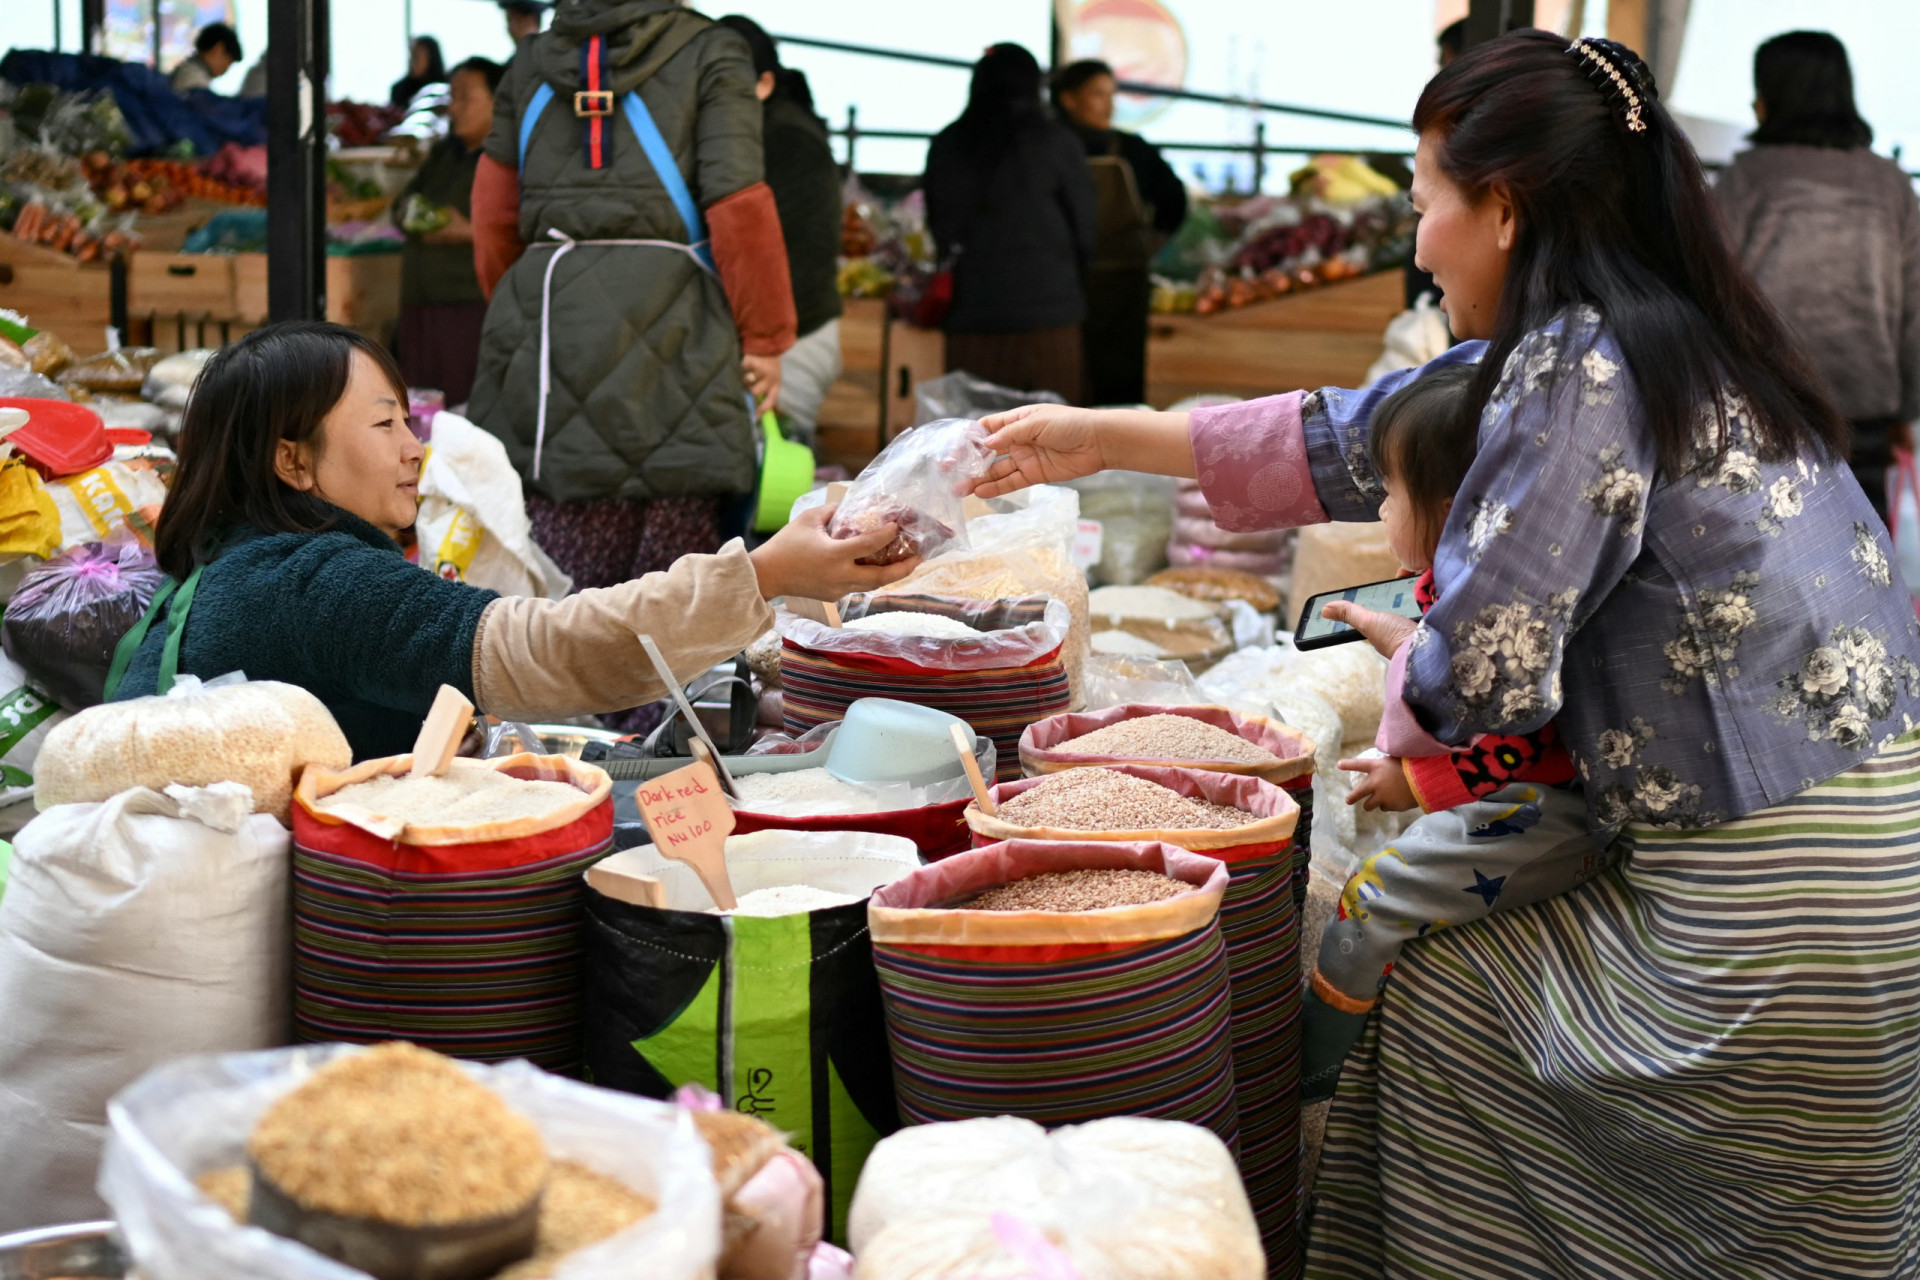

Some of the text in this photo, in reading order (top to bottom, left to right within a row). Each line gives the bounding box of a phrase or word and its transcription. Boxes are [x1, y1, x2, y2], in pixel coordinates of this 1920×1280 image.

[640, 776, 708, 806] Dark red
[653, 810, 686, 828] rice
[688, 820, 712, 838] 100
